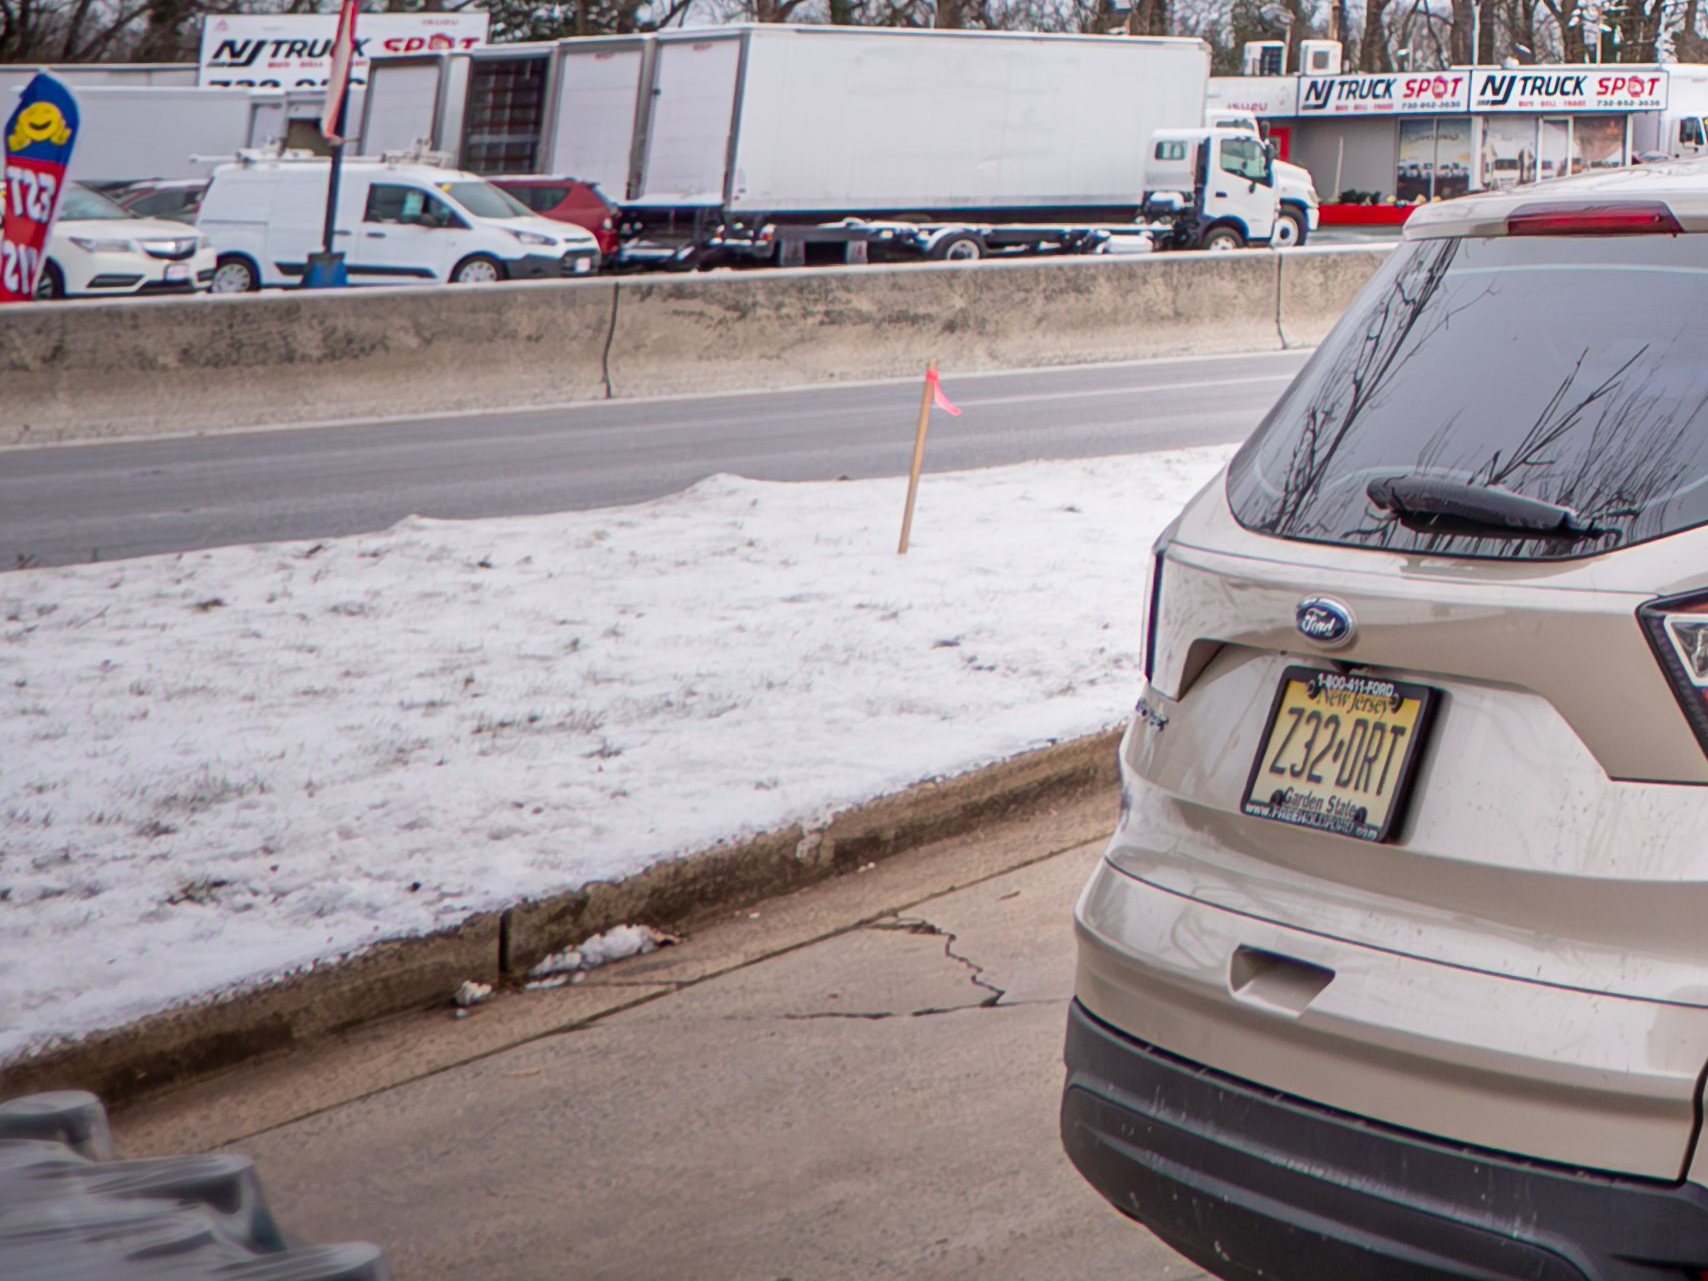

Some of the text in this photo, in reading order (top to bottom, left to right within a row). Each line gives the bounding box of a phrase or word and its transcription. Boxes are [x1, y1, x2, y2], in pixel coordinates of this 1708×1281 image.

[206, 39, 267, 68] NJ
[270, 38, 372, 58] TRUK
[1302, 75, 1463, 110] NJ TRUCK SPOT
[1477, 75, 1661, 105] NJ TRUCK SPOT
[1301, 607, 1337, 636] Ford
[1317, 687, 1390, 719] New Jersey
[1283, 786, 1358, 818] Garden State
